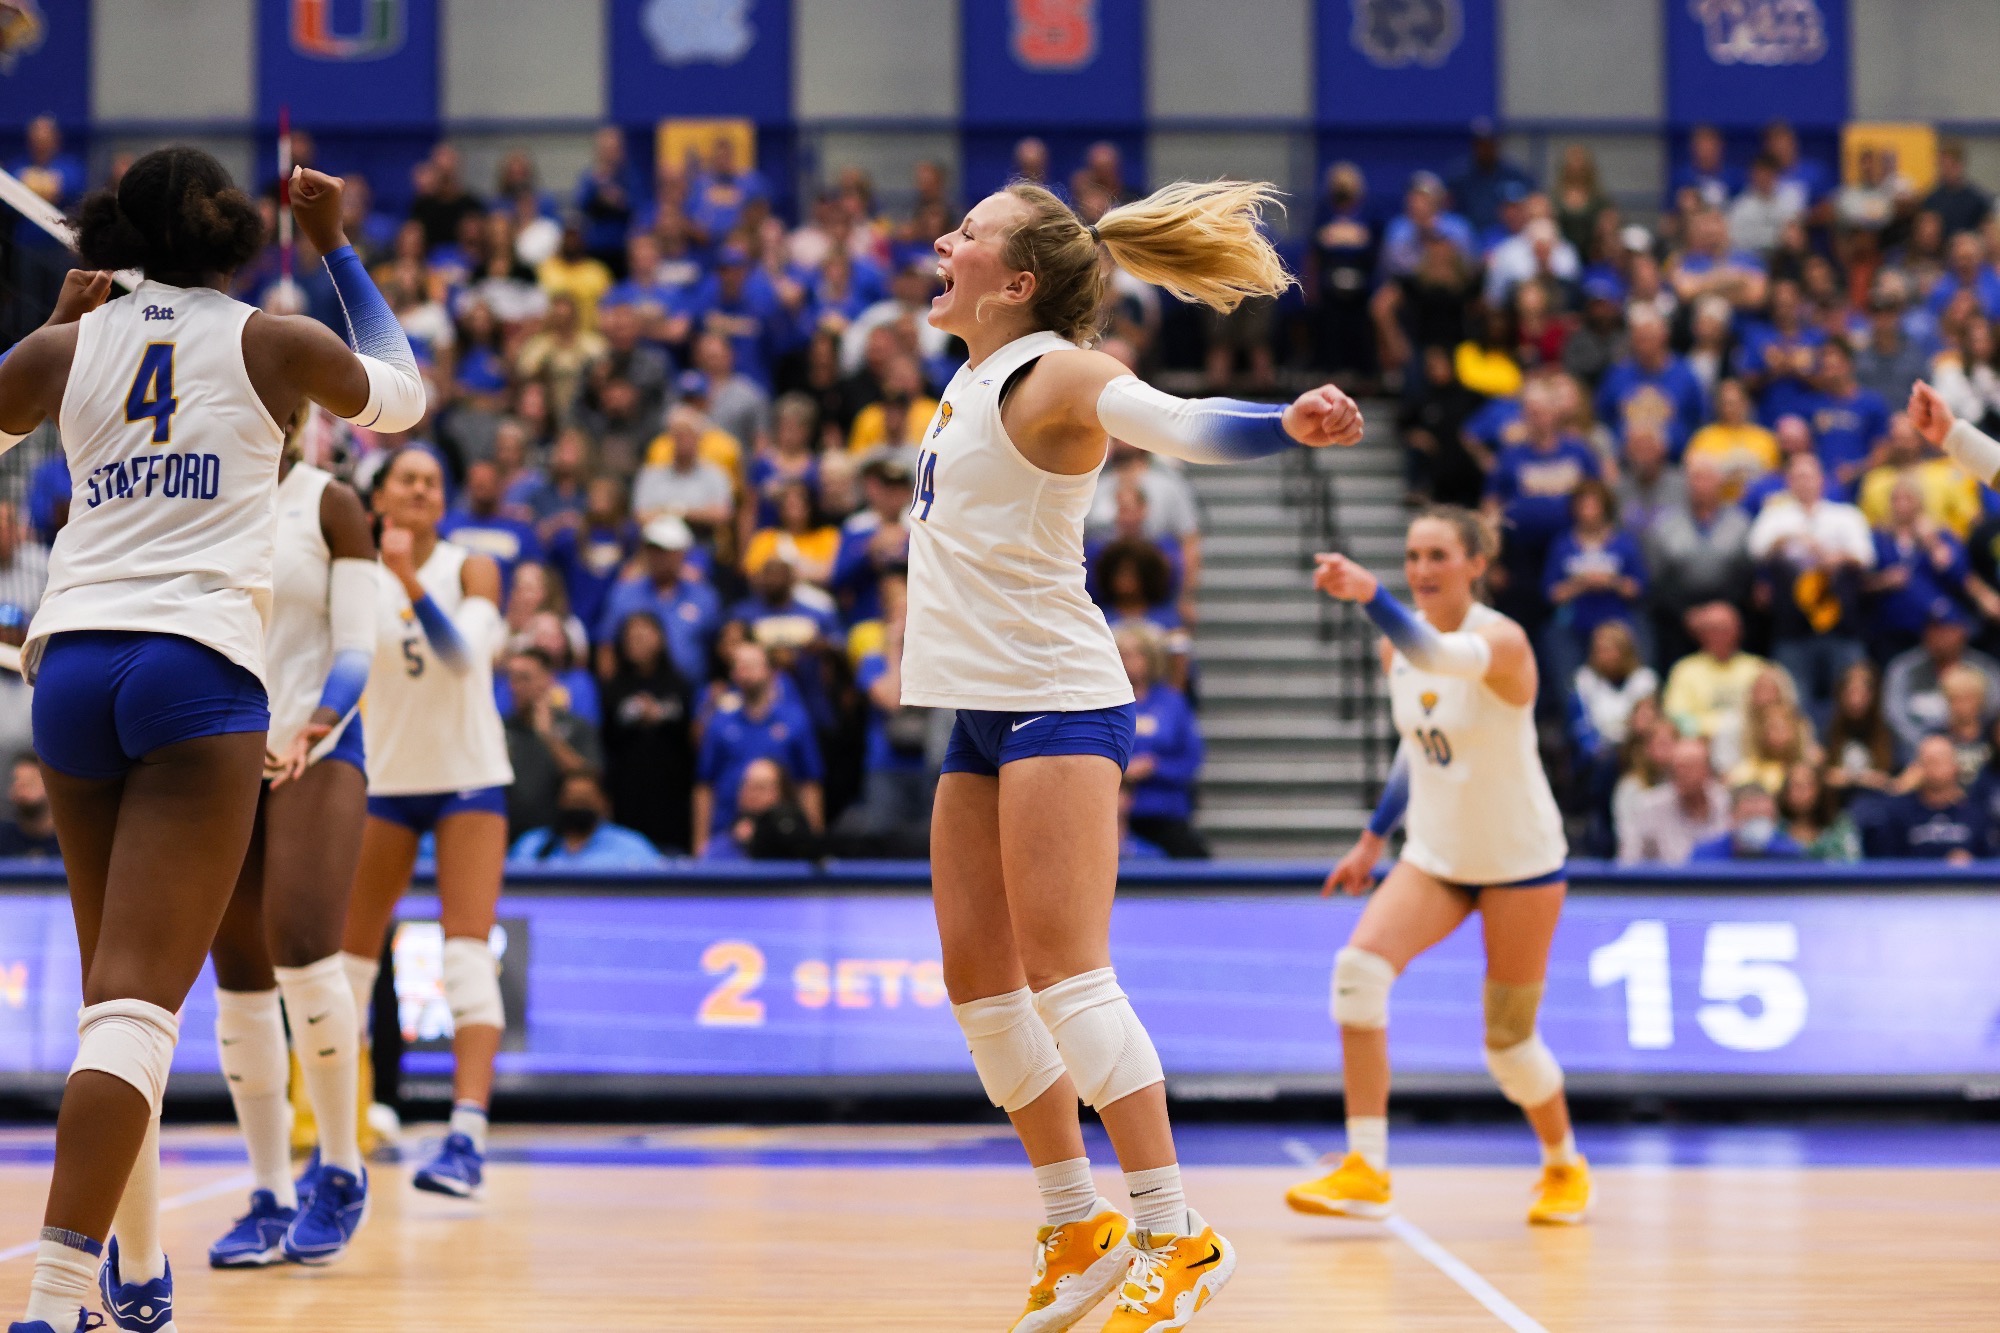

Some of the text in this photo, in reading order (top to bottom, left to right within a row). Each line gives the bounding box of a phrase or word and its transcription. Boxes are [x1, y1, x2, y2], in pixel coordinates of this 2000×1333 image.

[142, 304, 174, 321] Pitt
[124, 341, 179, 445] 4
[87, 453, 220, 509] STAFFORD
[909, 448, 938, 523] 14
[402, 637, 425, 678] 5
[698, 940, 946, 1027] 2 SETS
[1588, 918, 1809, 1052] 15
